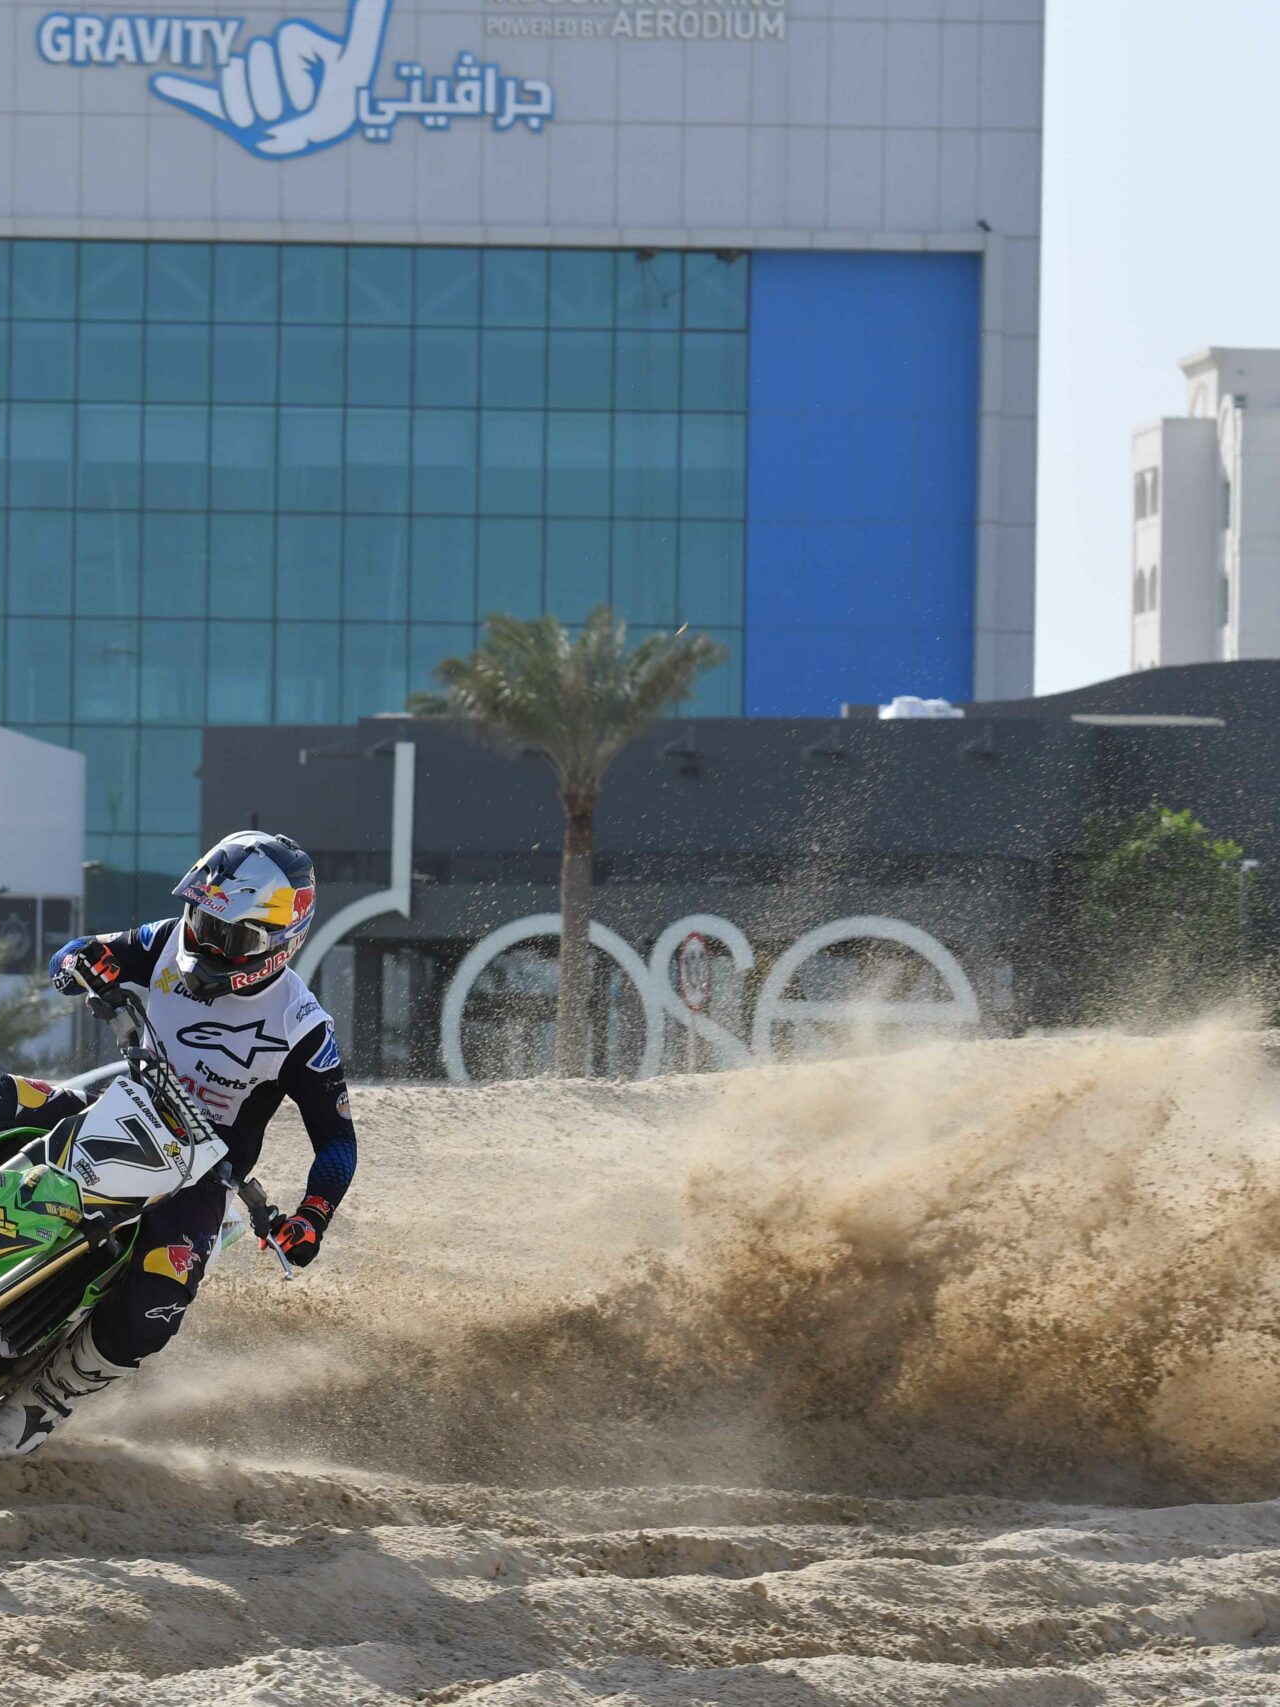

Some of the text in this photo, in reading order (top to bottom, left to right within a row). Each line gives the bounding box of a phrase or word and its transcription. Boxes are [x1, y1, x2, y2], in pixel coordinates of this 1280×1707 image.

[39, 14, 243, 67] GRAVITY
[486, 8, 786, 40] POWERED BY AERODIUM
[204, 895, 227, 913] Bull
[230, 957, 273, 991] Red
